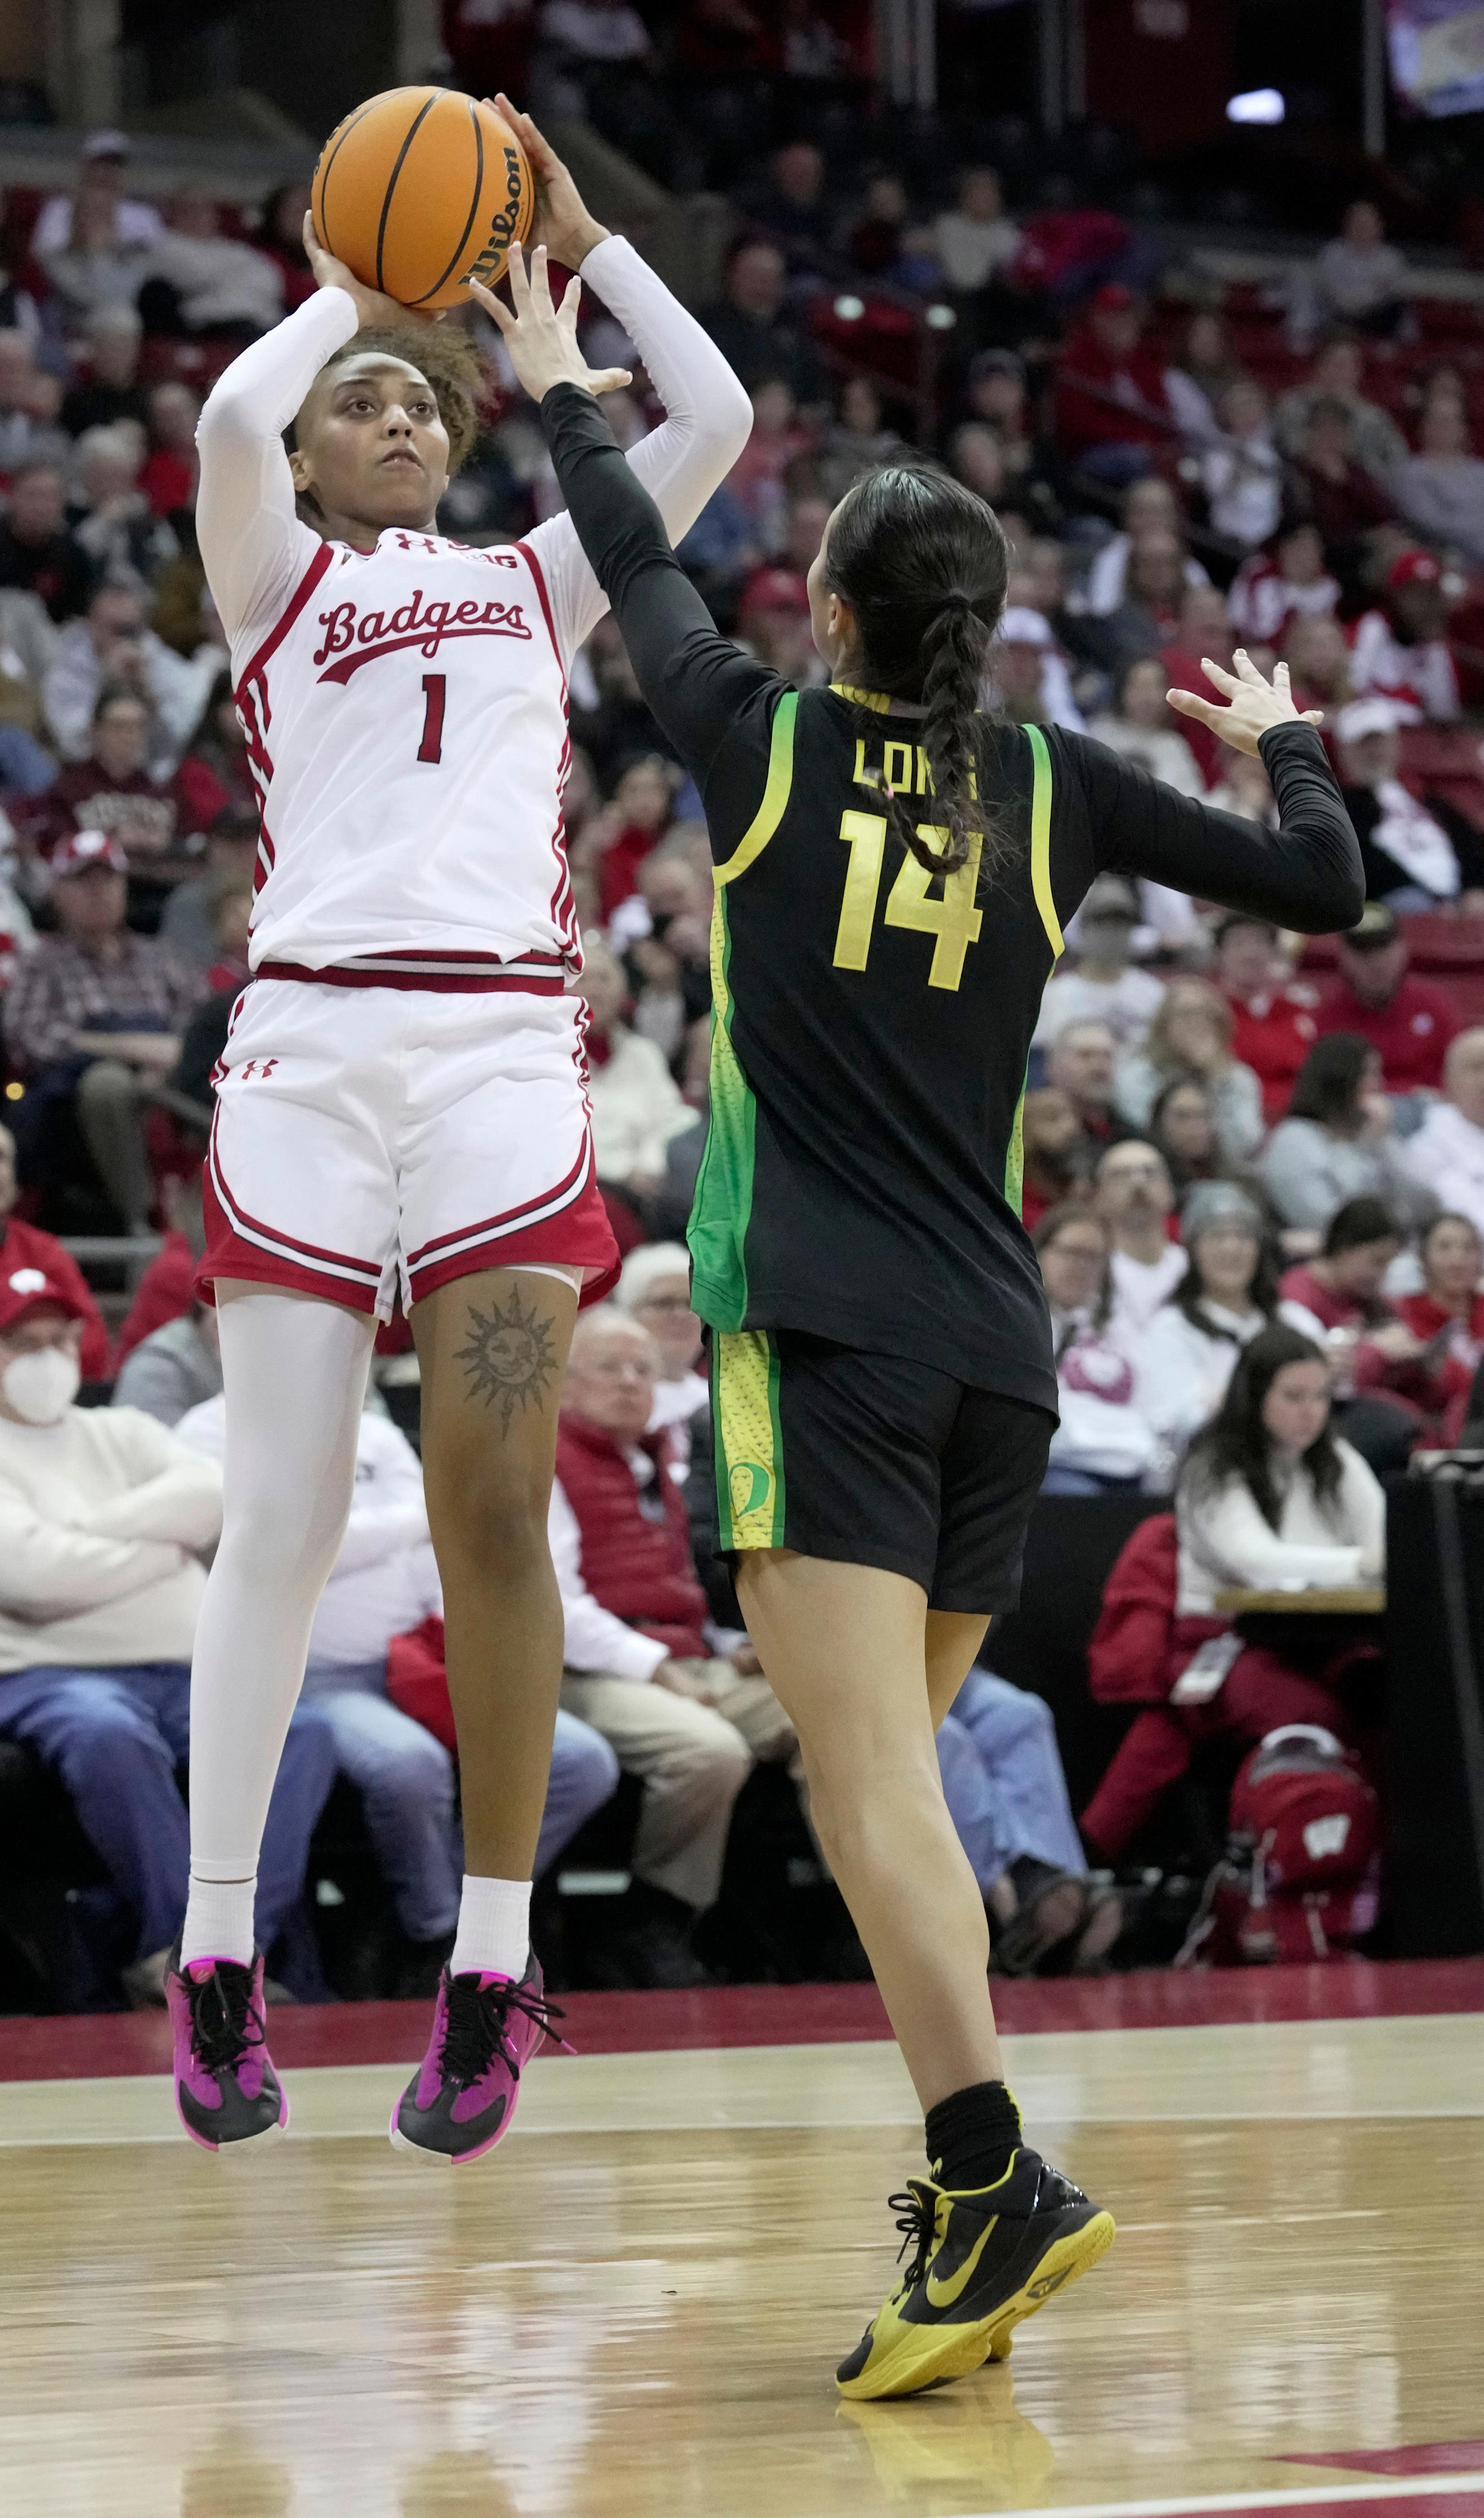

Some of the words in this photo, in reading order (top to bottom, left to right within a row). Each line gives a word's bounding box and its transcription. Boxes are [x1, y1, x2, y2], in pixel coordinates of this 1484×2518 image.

[458, 147, 521, 285] Wilson
[313, 589, 532, 666] Badgers
[416, 674, 446, 764] 1
[832, 809, 984, 992] 14
